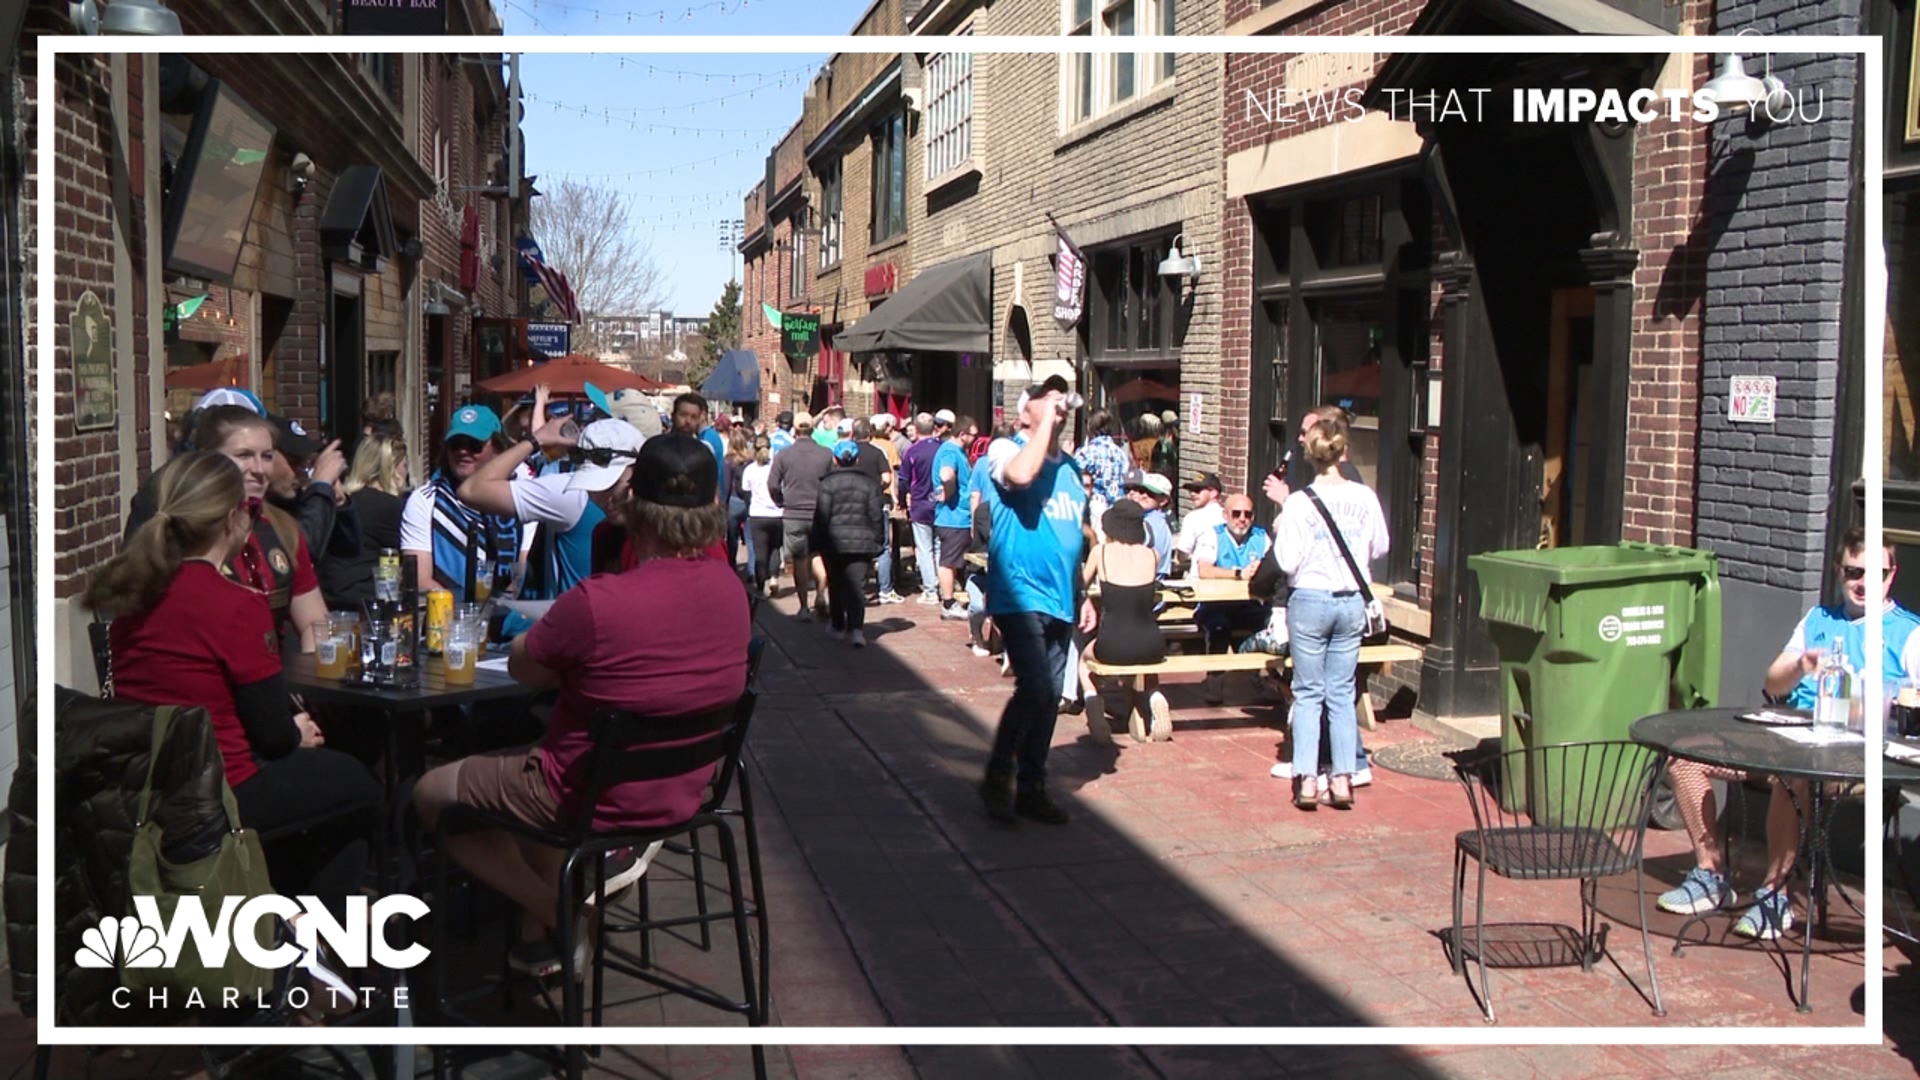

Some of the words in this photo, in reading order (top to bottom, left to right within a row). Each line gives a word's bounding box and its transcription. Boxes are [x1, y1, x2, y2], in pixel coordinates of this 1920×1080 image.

[410, 0, 437, 8] BAR
[1054, 305, 1082, 320] SHOP
[1733, 395, 1747, 416] NO
[1043, 491, 1085, 529] ally
